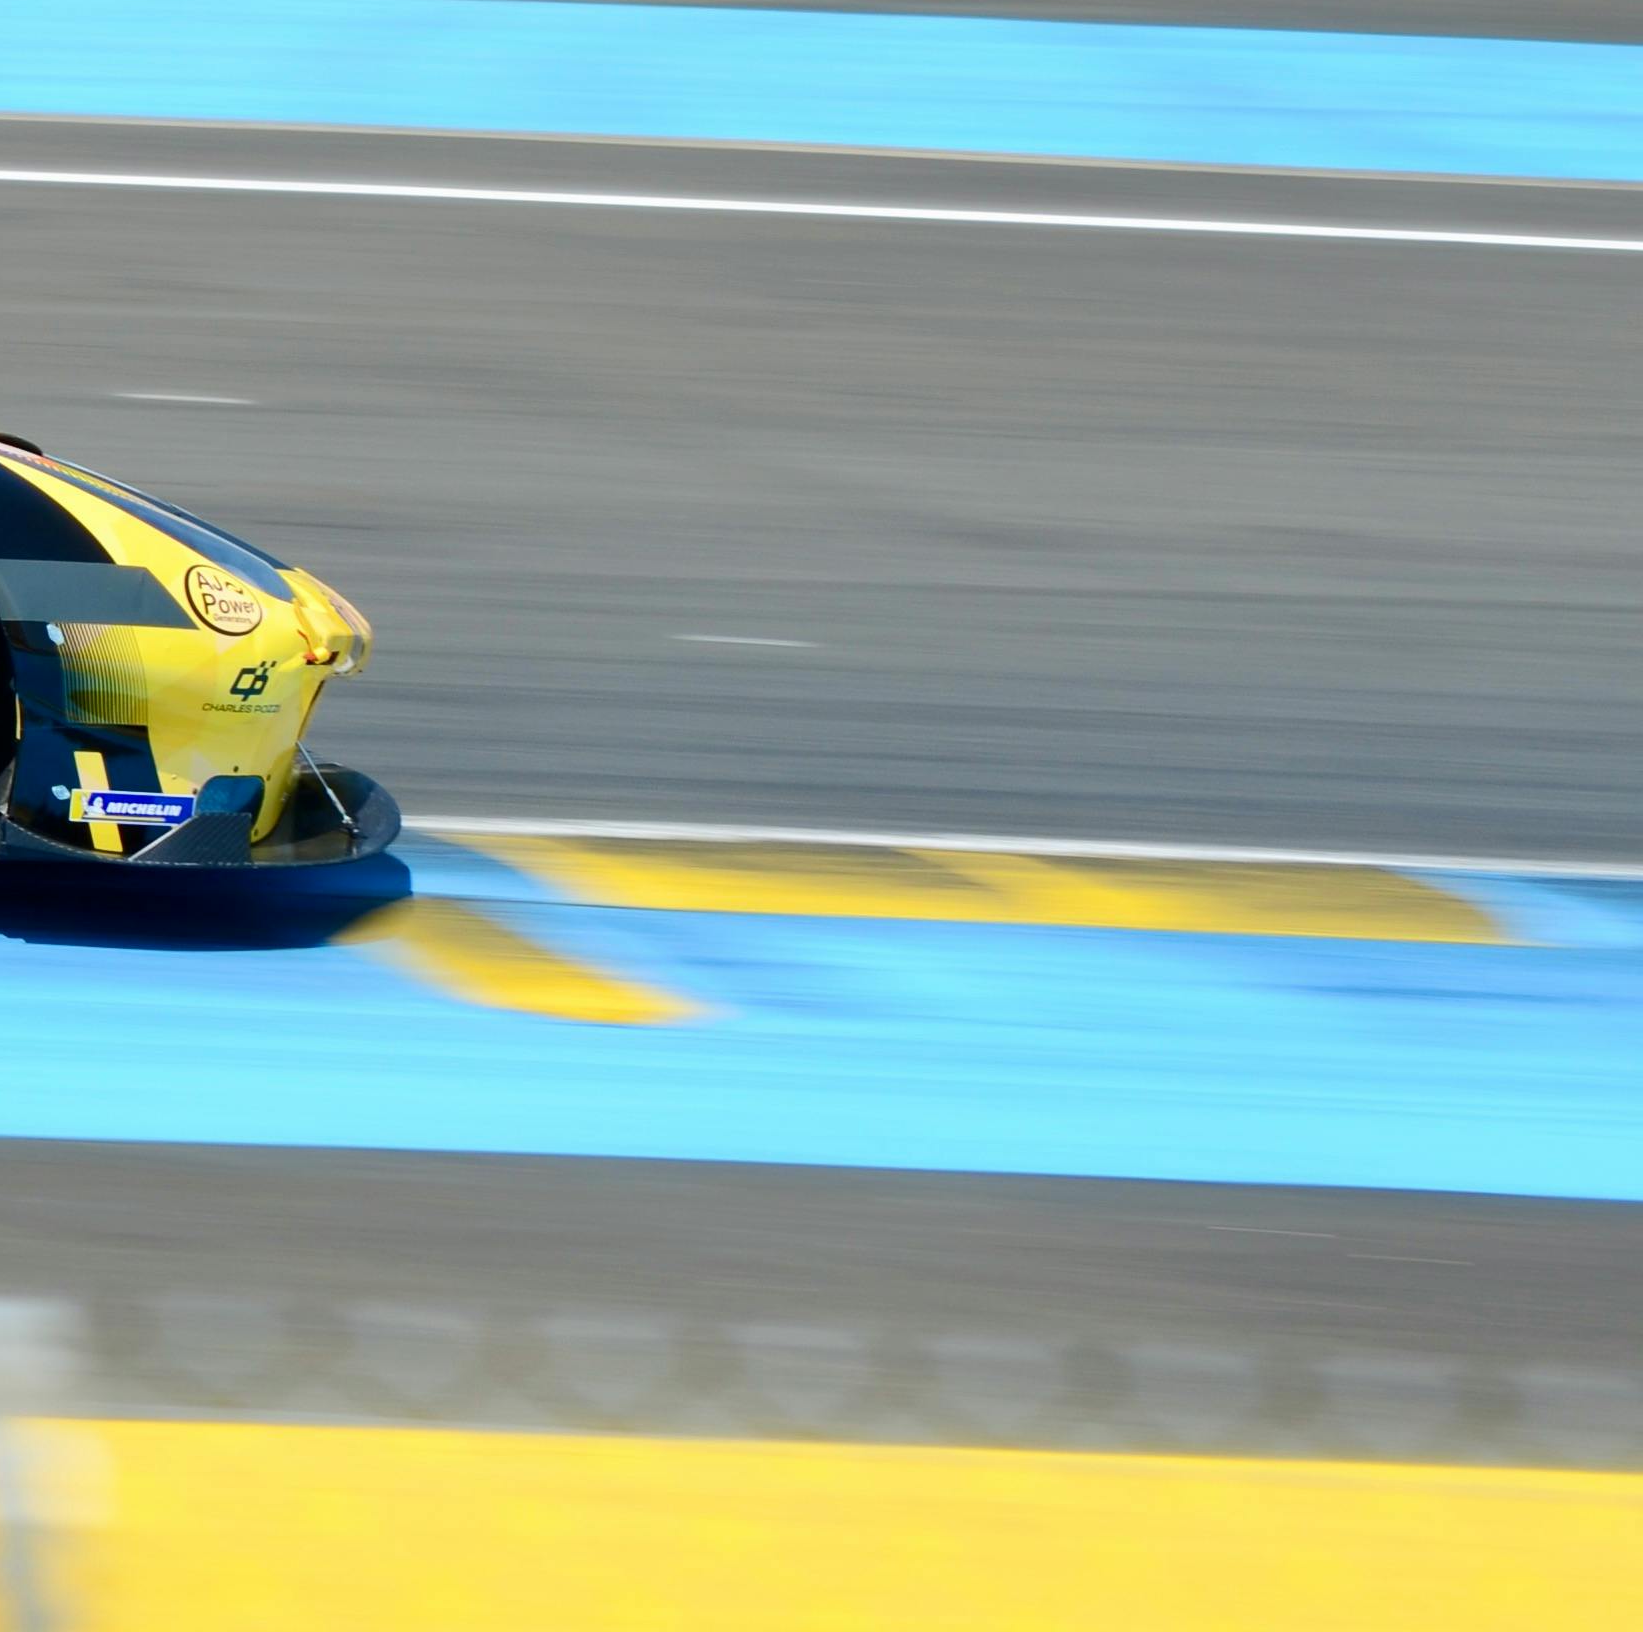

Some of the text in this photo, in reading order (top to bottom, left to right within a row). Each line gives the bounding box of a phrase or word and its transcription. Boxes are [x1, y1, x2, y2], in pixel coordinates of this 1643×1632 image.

[197, 571, 223, 591] AJ
[201, 593, 254, 615] Power
[202, 703, 252, 713] CHARLES
[106, 802, 182, 817] MICHELIN
